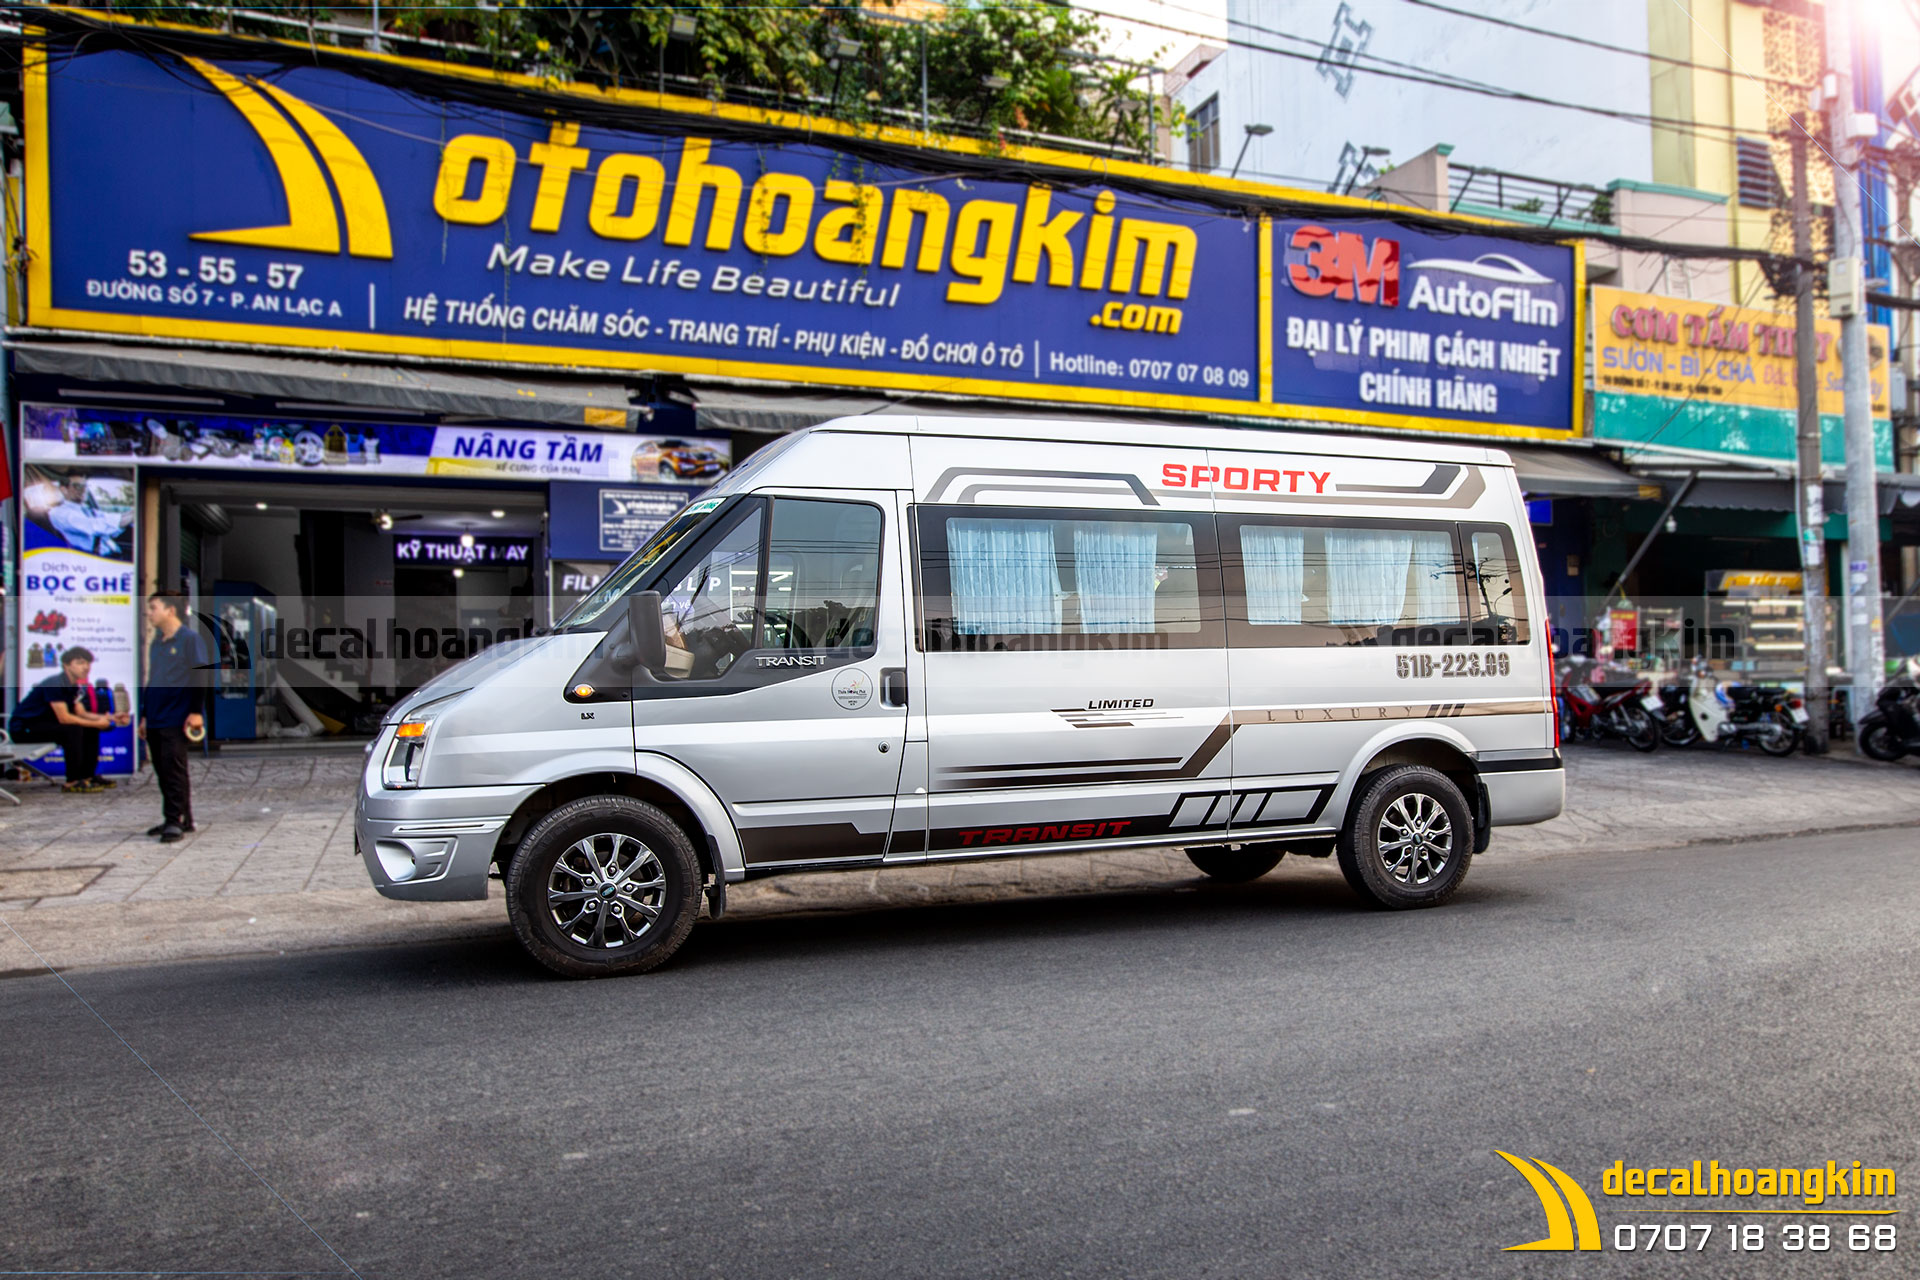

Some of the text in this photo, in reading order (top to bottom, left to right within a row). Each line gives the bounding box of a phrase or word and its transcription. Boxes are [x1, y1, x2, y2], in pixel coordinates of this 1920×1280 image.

[432, 121, 1198, 304] otohoangkim
[128, 250, 167, 278] 53
[199, 256, 236, 284] 55
[267, 263, 303, 290] 57
[487, 243, 900, 308] Make Life Beautiful
[1288, 225, 1399, 307] 3M
[86, 277, 163, 302] ĐƯỜNG
[168, 281, 198, 305] SỐ
[202, 290, 213, 306] 7
[252, 294, 280, 314] AN
[286, 298, 323, 318] LẠC
[328, 300, 343, 318] A
[1408, 275, 1558, 328] AutoFilm
[403, 293, 438, 326] HỆ
[445, 292, 526, 330] THỐNG
[532, 304, 598, 334] CHĂM
[603, 308, 650, 338] SÓC
[668, 318, 740, 346] TRANG
[746, 323, 781, 349] TRÍ
[794, 329, 837, 358] PHỤ
[840, 331, 886, 360] KIỆN
[901, 333, 930, 361] ĐỒ
[932, 341, 977, 365] CHƠI
[981, 341, 996, 366] Ô
[999, 343, 1024, 368] TÔ
[1090, 301, 1184, 335] .com
[1611, 304, 1833, 363] CƠM TẤM THY
[1287, 316, 1562, 382] ĐẠI LÝ PHIM CÁCH NHIỆT
[1049, 351, 1250, 389] Hotline: 0707 07 08 09
[1360, 368, 1498, 414] CHÍNH HÃNG
[453, 432, 604, 463] NÂNG TẦM
[1161, 463, 1332, 494] SPORTY
[397, 539, 421, 559] KỸ
[26, 571, 134, 596] BỌC GHẾ
[755, 655, 827, 667] TRANSIT
[1088, 699, 1154, 710] LIMITED
[1267, 705, 1413, 722] LUXURY
[959, 820, 1132, 846] TRANSIT
